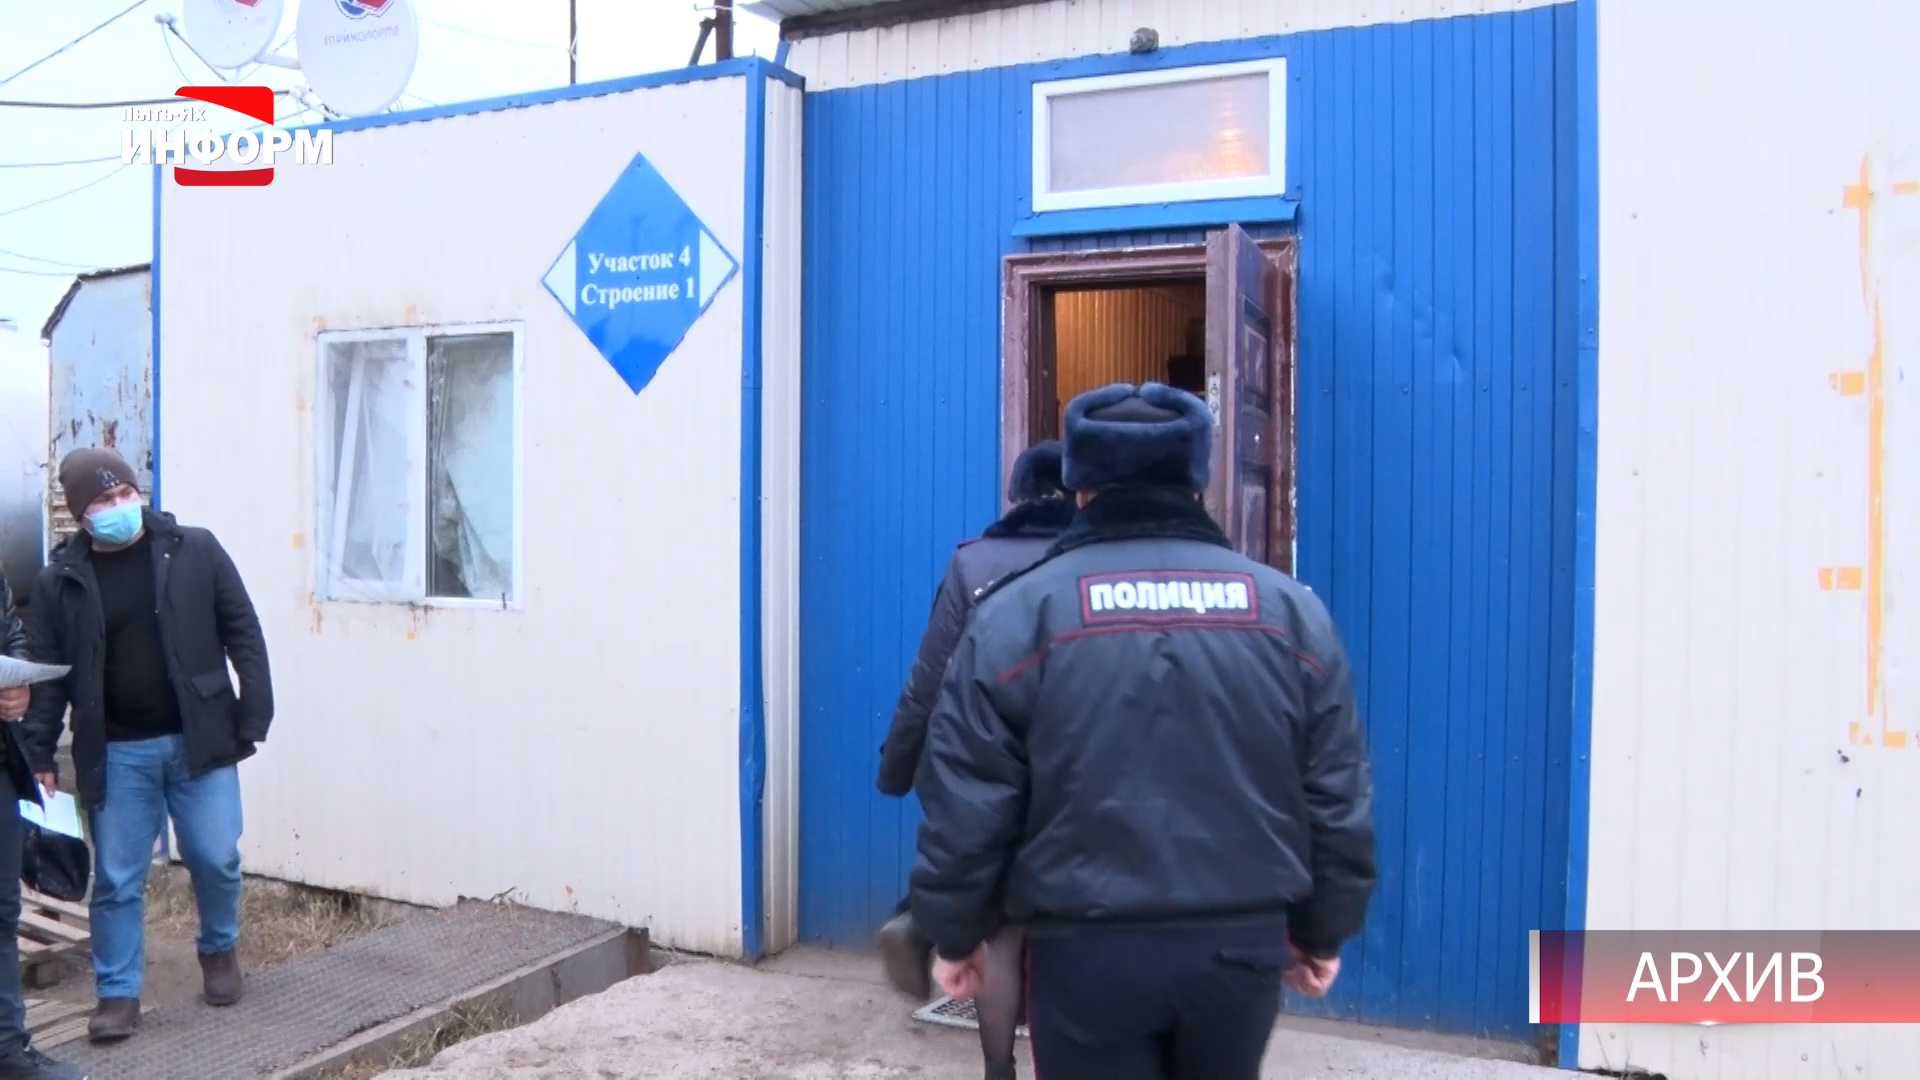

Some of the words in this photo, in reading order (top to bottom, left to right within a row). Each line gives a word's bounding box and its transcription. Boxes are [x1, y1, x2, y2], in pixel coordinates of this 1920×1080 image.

[588, 252, 674, 275] Участок
[679, 245, 691, 267] 4
[581, 283, 679, 310] Строение
[685, 276, 695, 298] 1
[1089, 580, 1249, 614] ПОЛИЦИЯ
